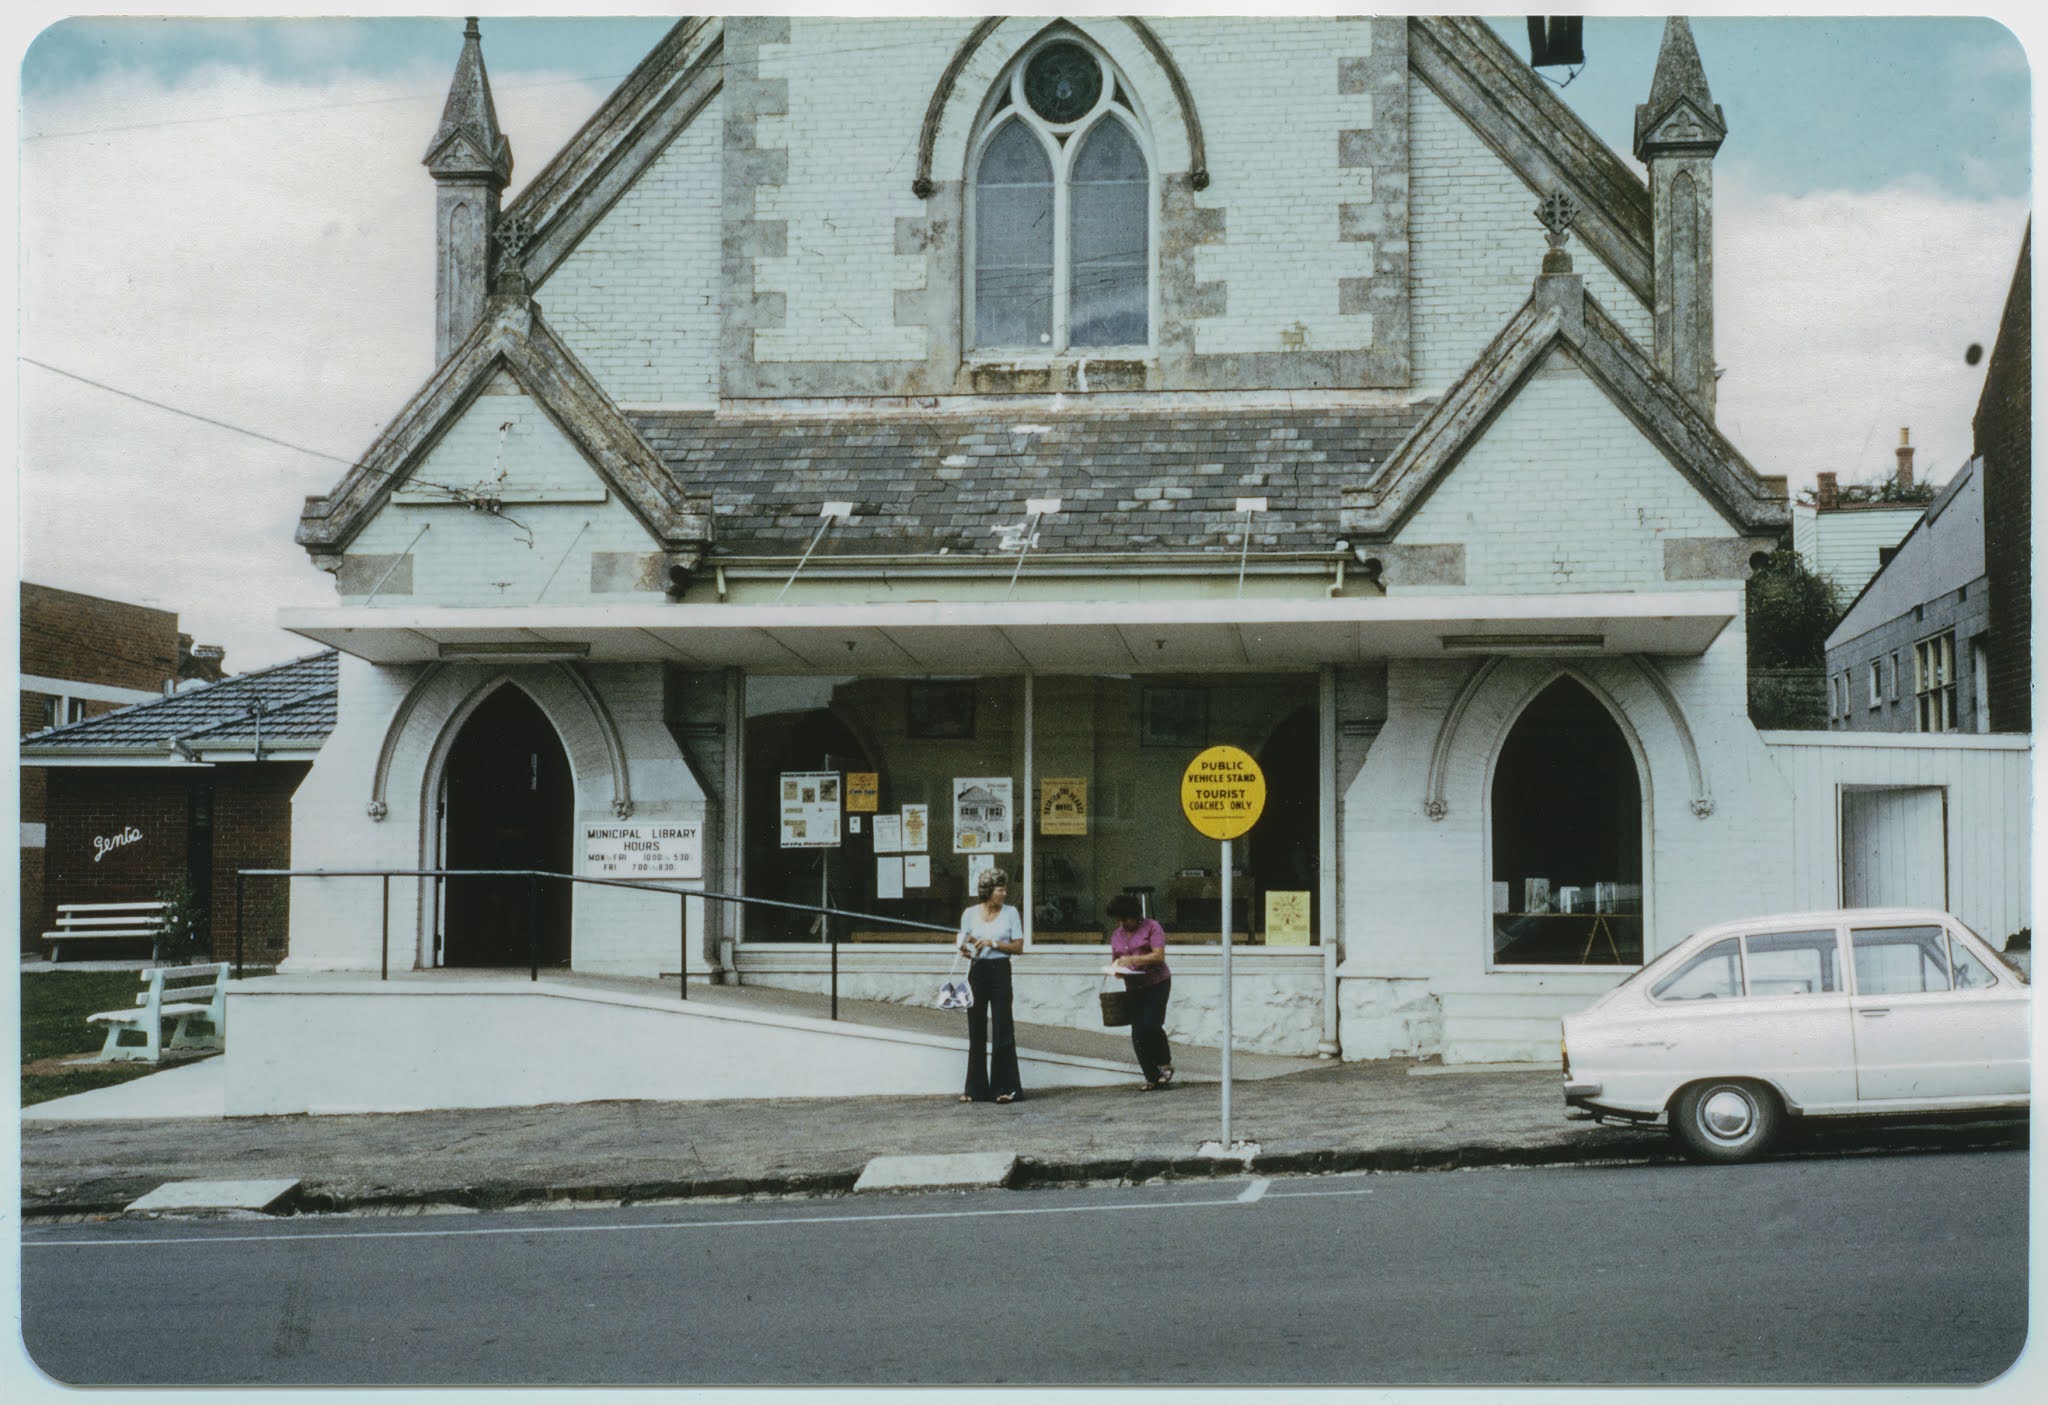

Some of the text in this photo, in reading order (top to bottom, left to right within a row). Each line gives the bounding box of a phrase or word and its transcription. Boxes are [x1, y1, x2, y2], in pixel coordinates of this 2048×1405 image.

[1201, 761, 1243, 771] PUBLIC
[1188, 774, 1256, 783] VEHICLE STAND
[1195, 789, 1245, 799] TOURIST
[1189, 801, 1252, 811] COACHES ONLY
[587, 829, 696, 839] MUNICIPAL LIBRARY
[623, 841, 660, 851] HOURS
[613, 853, 627, 861] FRI
[603, 863, 617, 871] FRI
